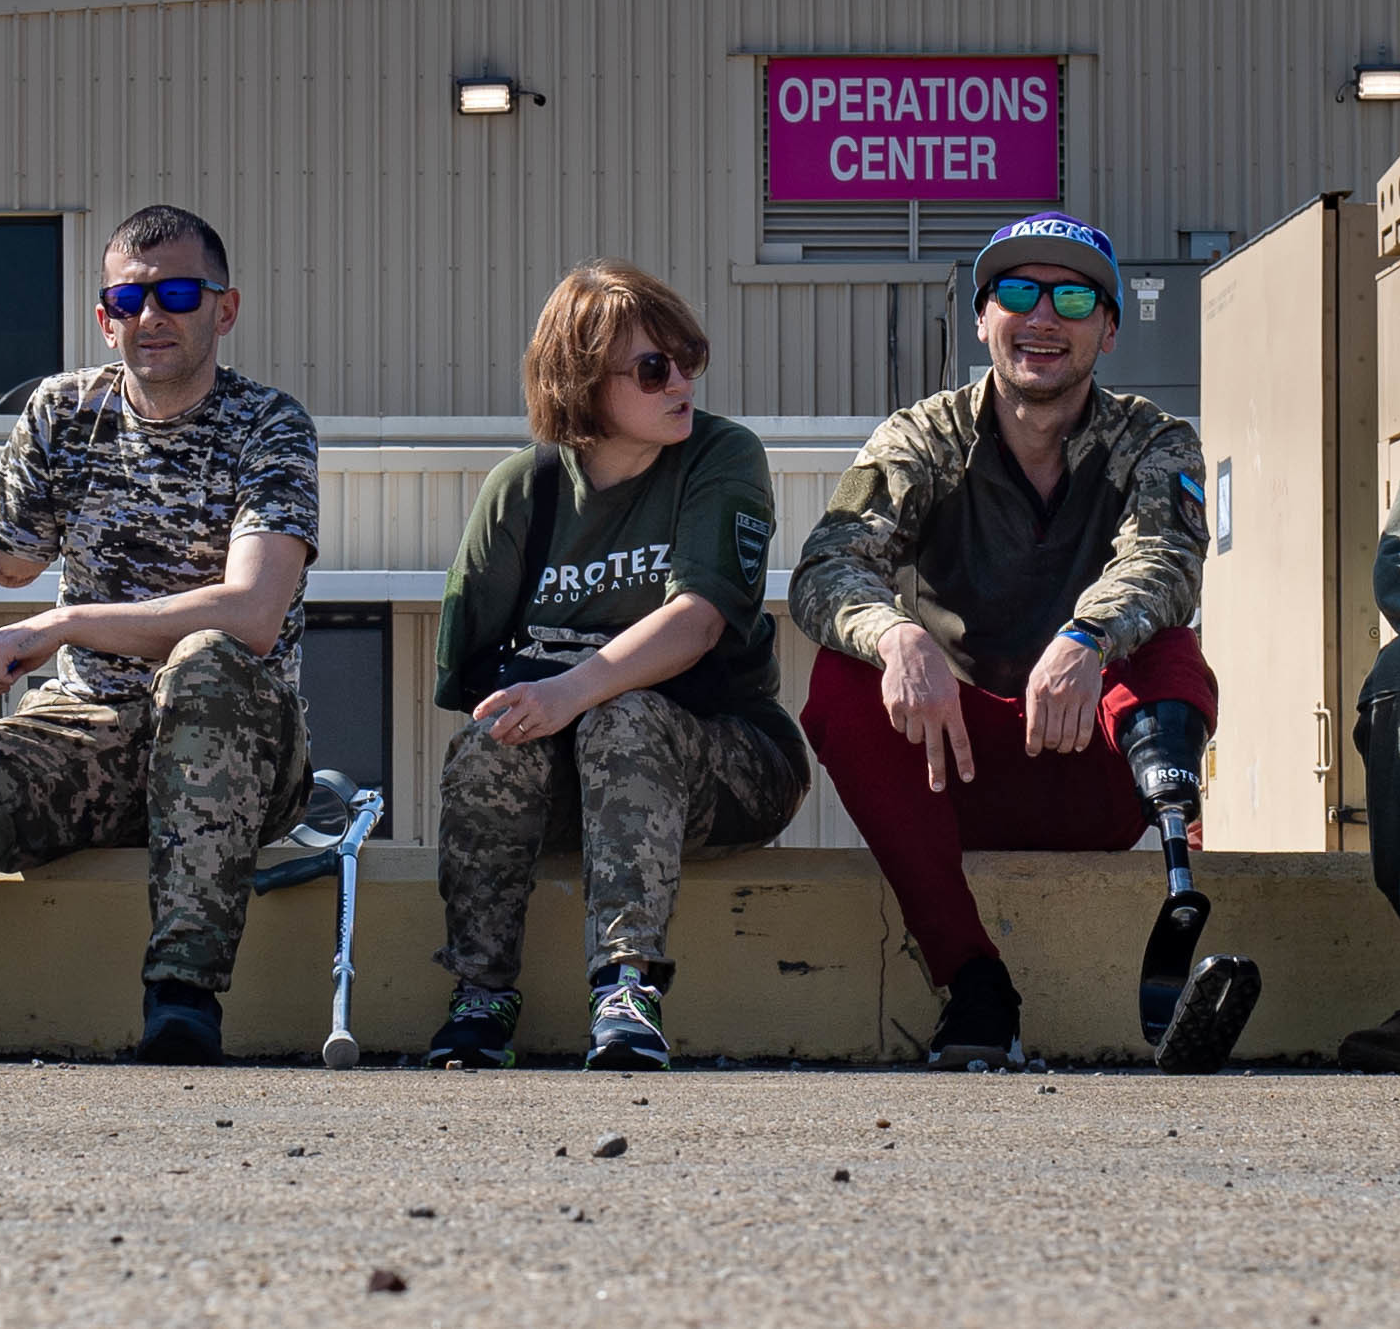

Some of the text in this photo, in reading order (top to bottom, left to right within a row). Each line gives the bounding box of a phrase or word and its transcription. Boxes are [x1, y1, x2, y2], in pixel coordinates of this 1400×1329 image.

[778, 76, 1049, 123] OPERATIONS
[829, 135, 998, 181] CENTER
[538, 544, 671, 592] PROTEZ
[541, 572, 669, 604] FOUNDATIO
